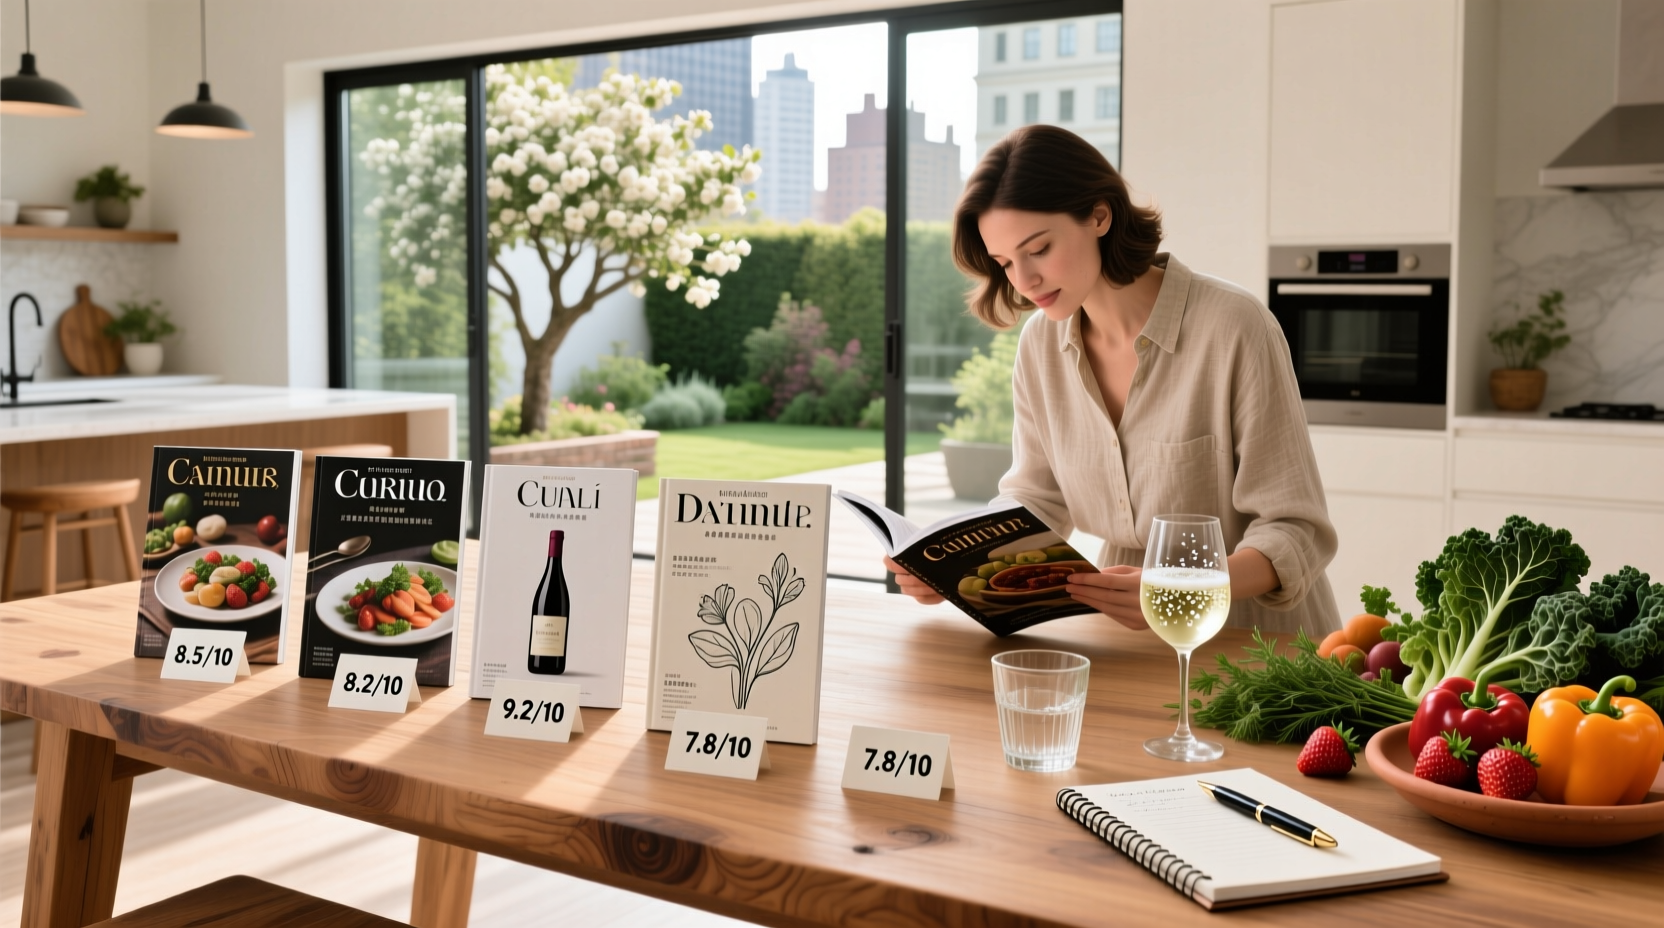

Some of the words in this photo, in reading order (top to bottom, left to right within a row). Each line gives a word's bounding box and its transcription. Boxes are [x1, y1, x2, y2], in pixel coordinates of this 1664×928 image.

[174, 644, 234, 668] 8.5/10
[343, 671, 403, 697] 8.2/10
[503, 698, 565, 725] 9.2/10
[685, 730, 752, 760] 7.8/10
[864, 747, 932, 778] 7.8/10
